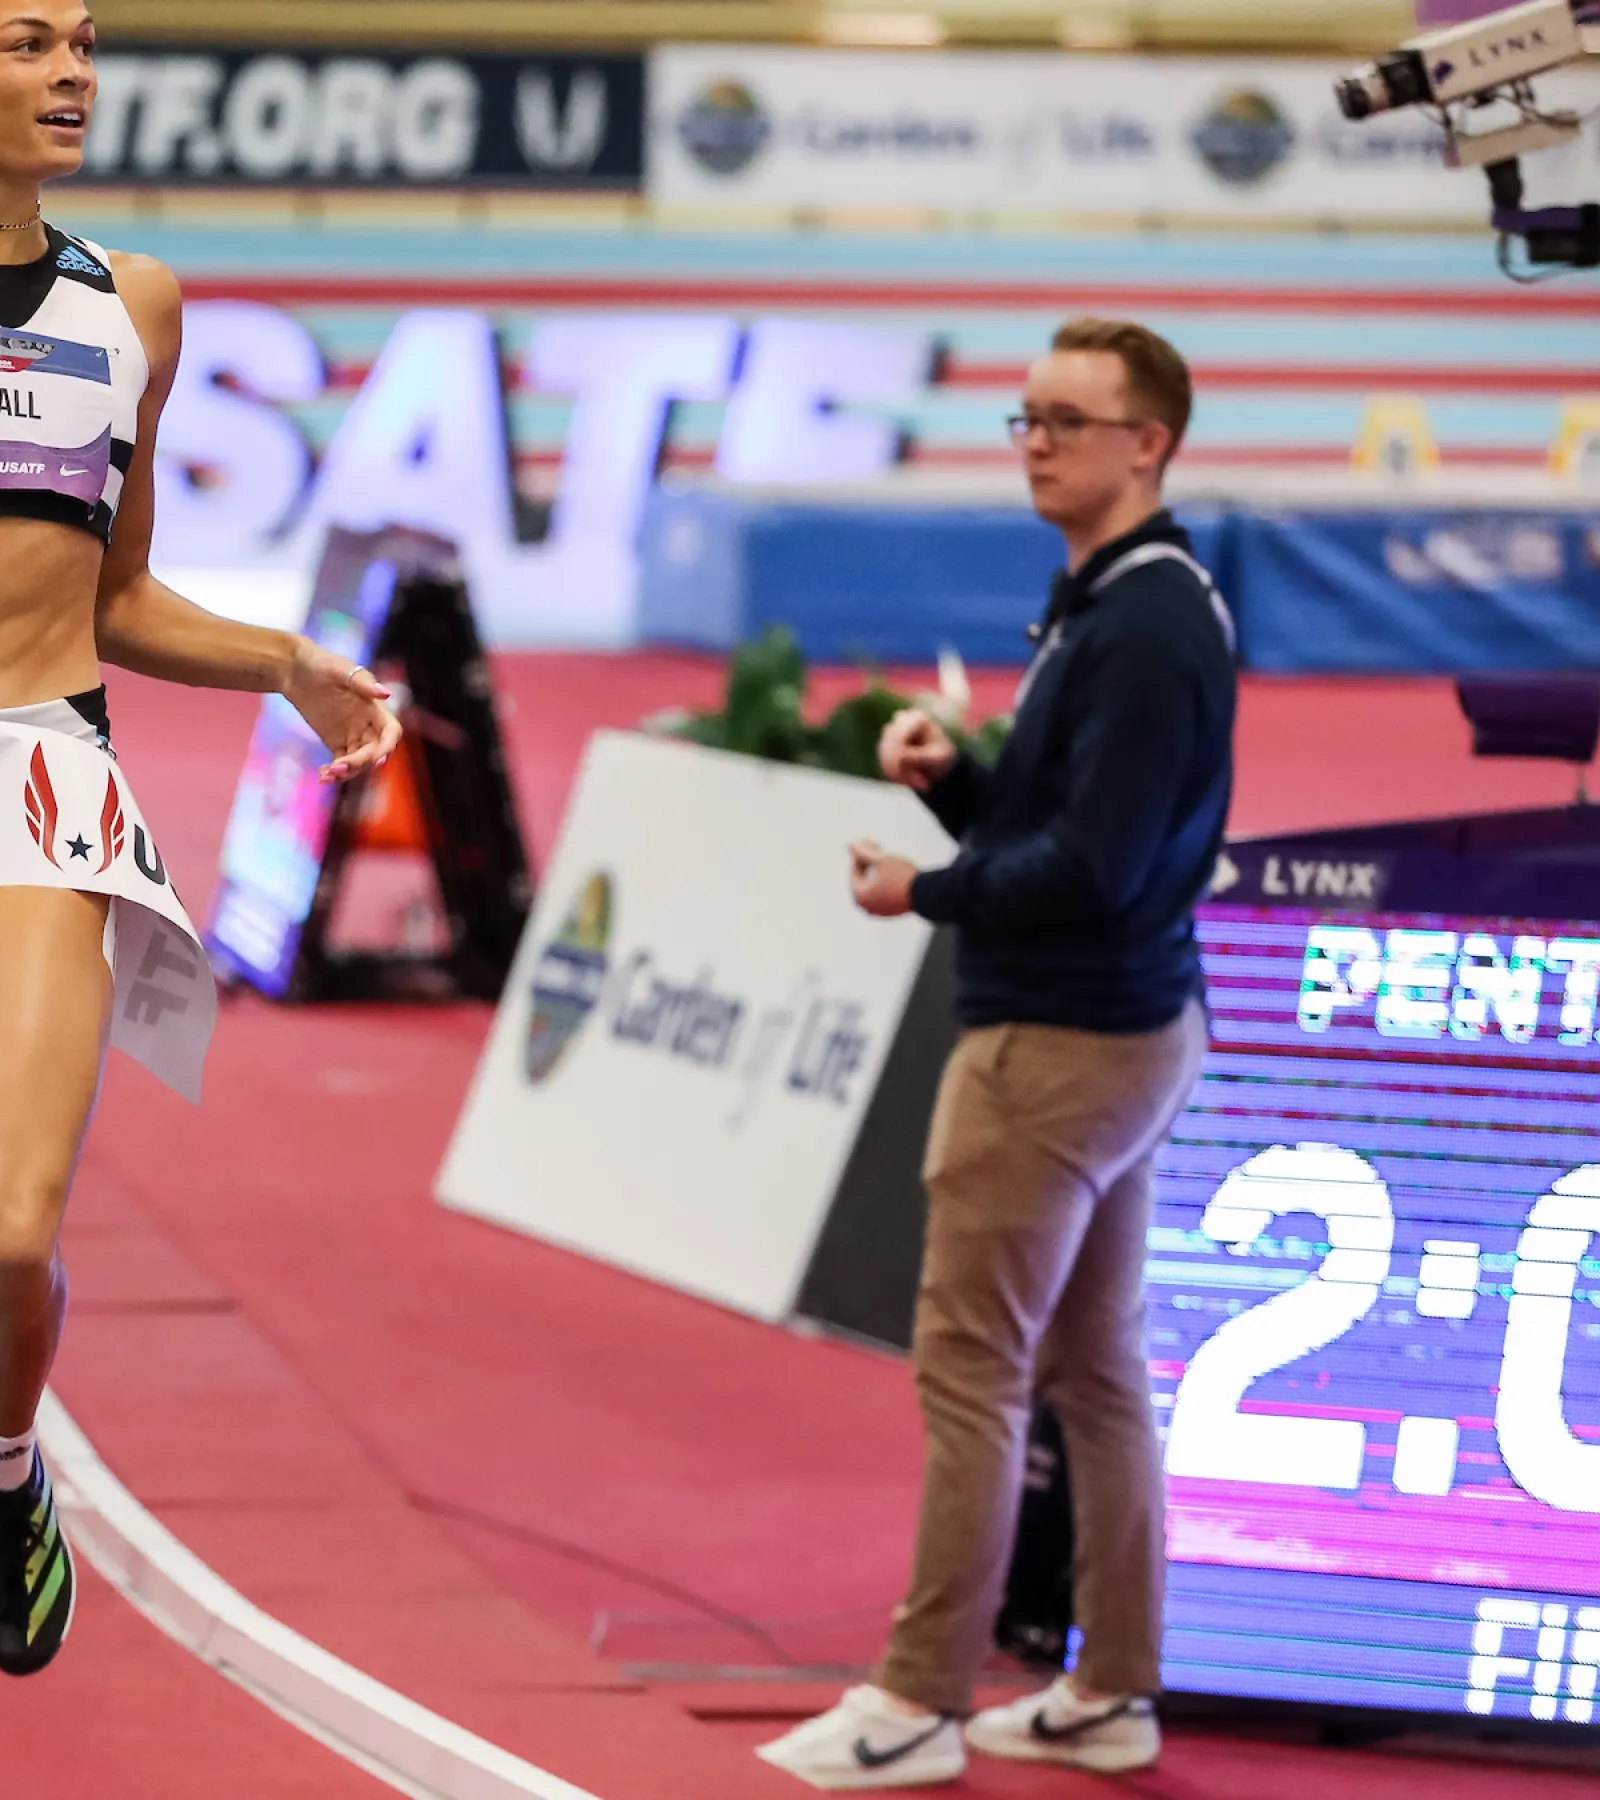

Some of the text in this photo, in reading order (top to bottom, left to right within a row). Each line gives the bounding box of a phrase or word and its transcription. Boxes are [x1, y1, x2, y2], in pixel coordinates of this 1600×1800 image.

[1468, 29, 1547, 68] LYNX
[55, 259, 106, 277] adidas
[1261, 855, 1377, 897] LYNX
[1298, 925, 1600, 1047] PENT
